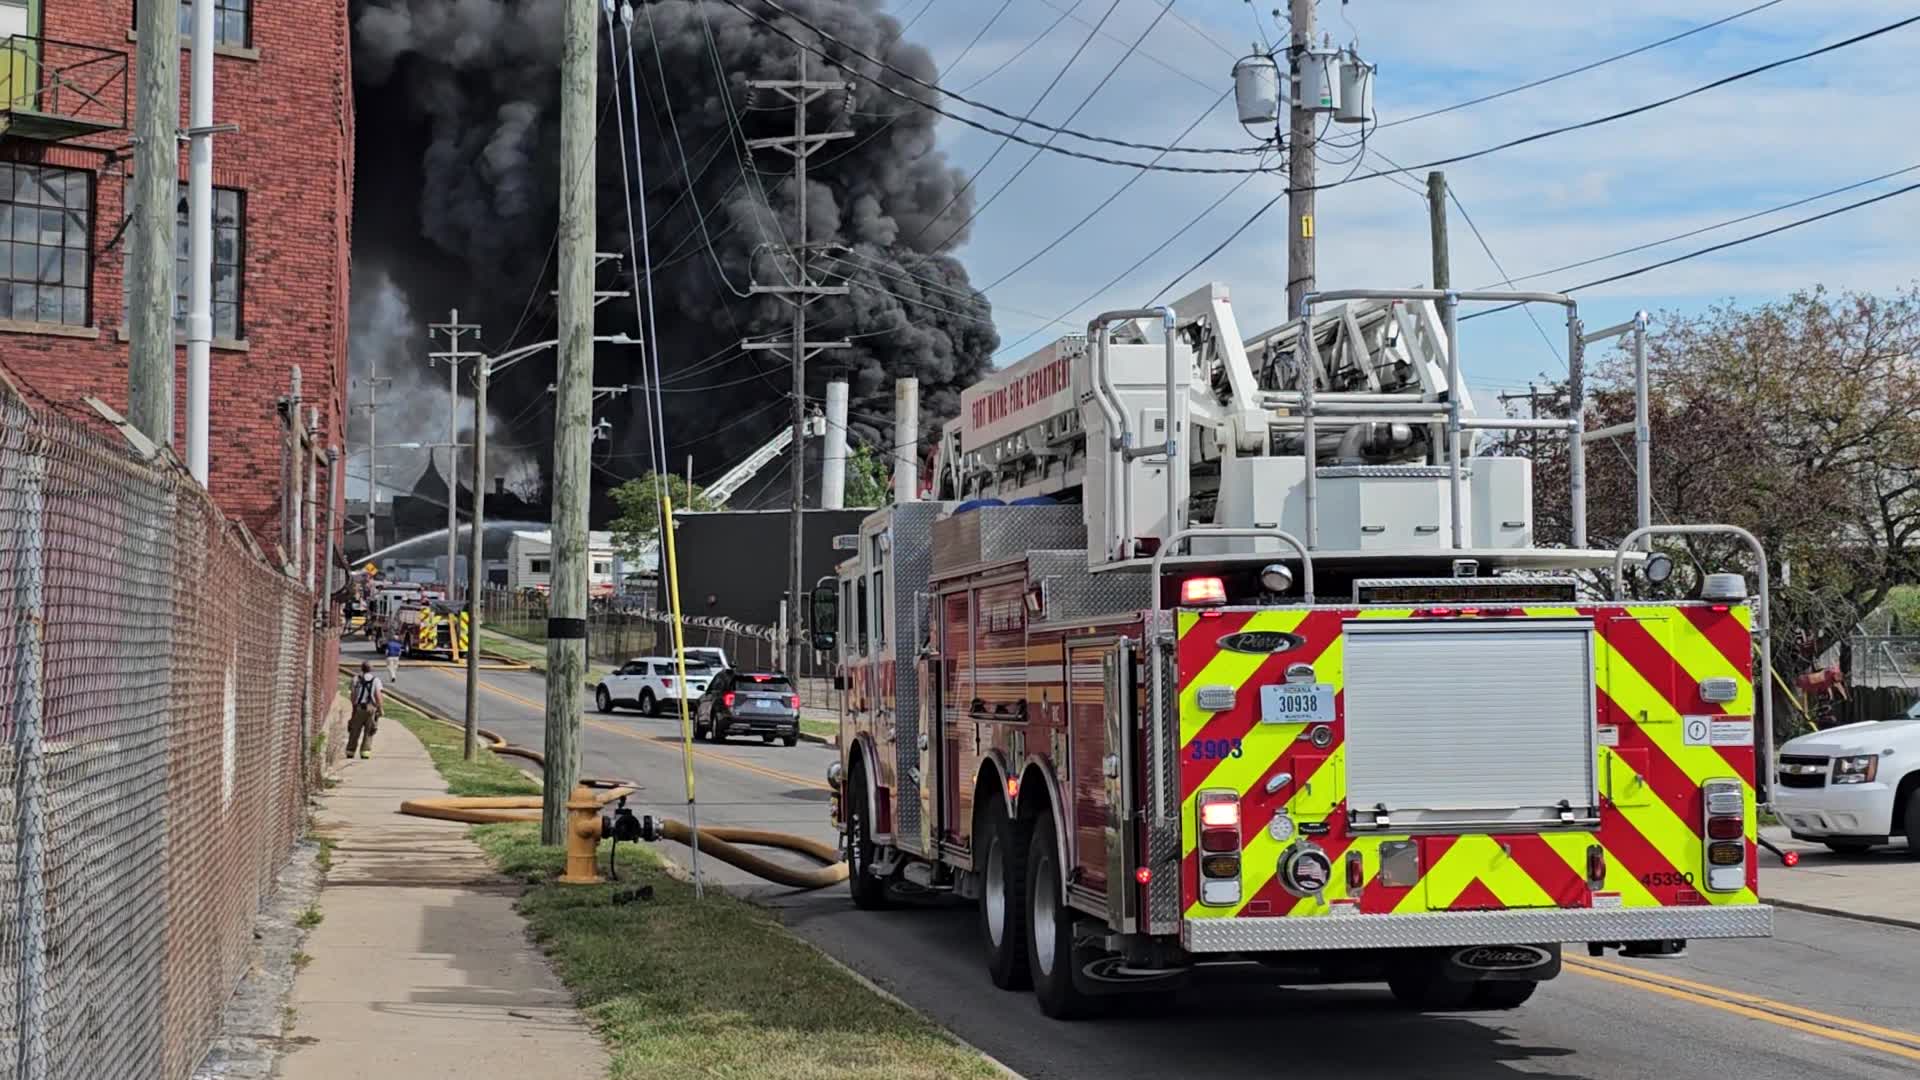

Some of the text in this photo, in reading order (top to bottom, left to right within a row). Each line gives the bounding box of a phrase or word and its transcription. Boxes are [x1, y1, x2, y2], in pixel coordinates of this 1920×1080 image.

[972, 357, 1071, 431] FORT WAYNE FIRE DEPARTMENT
[1279, 694, 1318, 713] 30938
[1191, 737, 1243, 760] 3903
[1641, 871, 1694, 886] 45390
